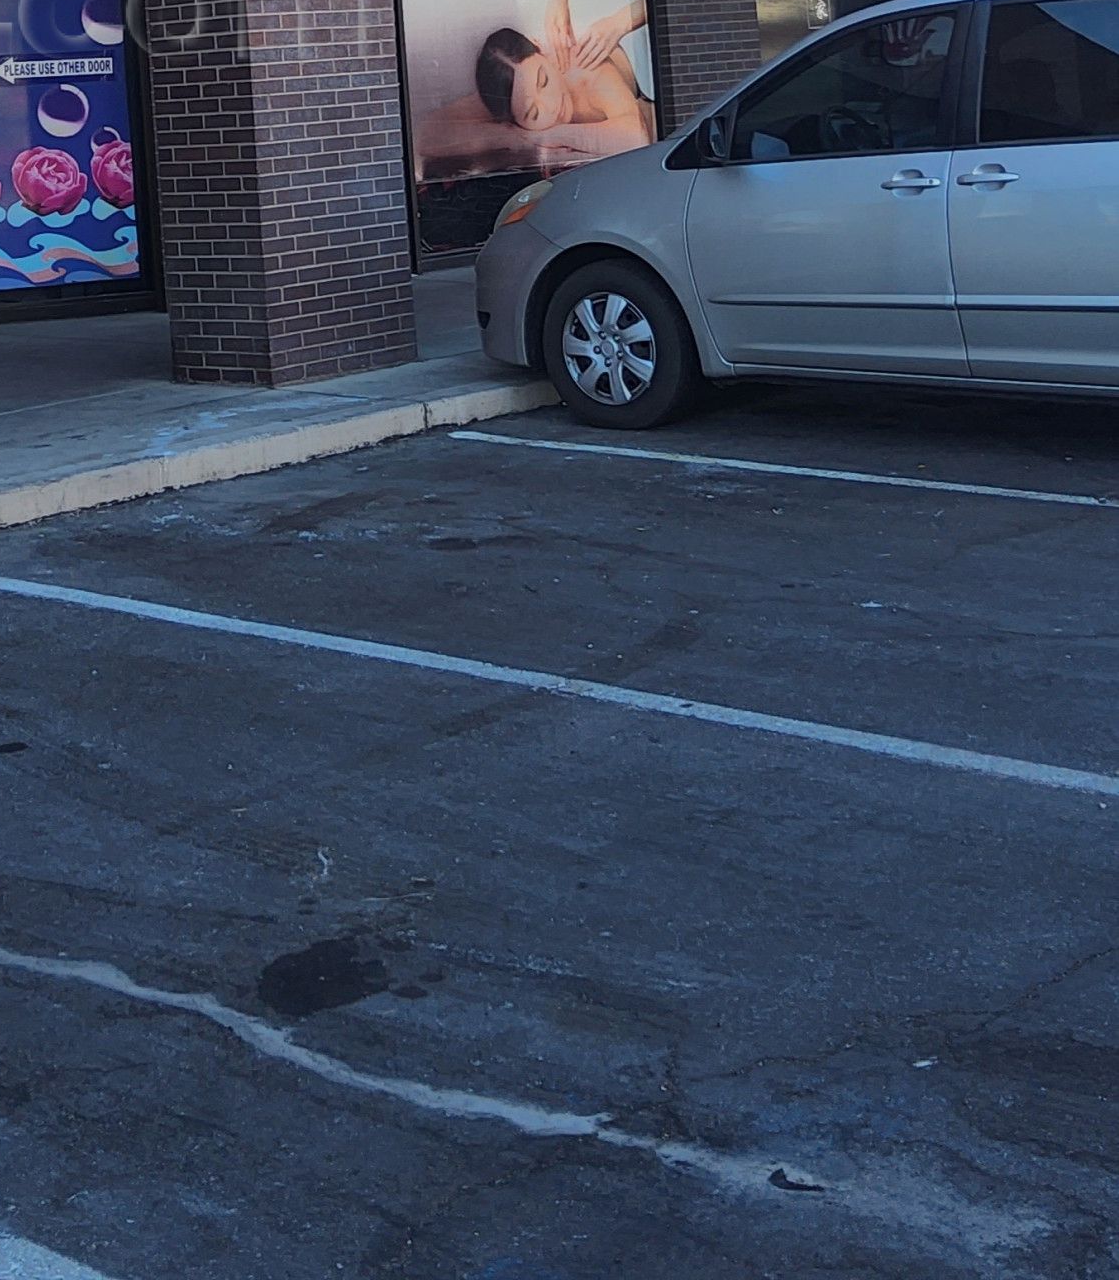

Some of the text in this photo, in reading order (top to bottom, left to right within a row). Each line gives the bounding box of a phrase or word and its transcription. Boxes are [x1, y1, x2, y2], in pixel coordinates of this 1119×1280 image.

[4, 59, 112, 76] PLEASE USE OTHER DOOR
